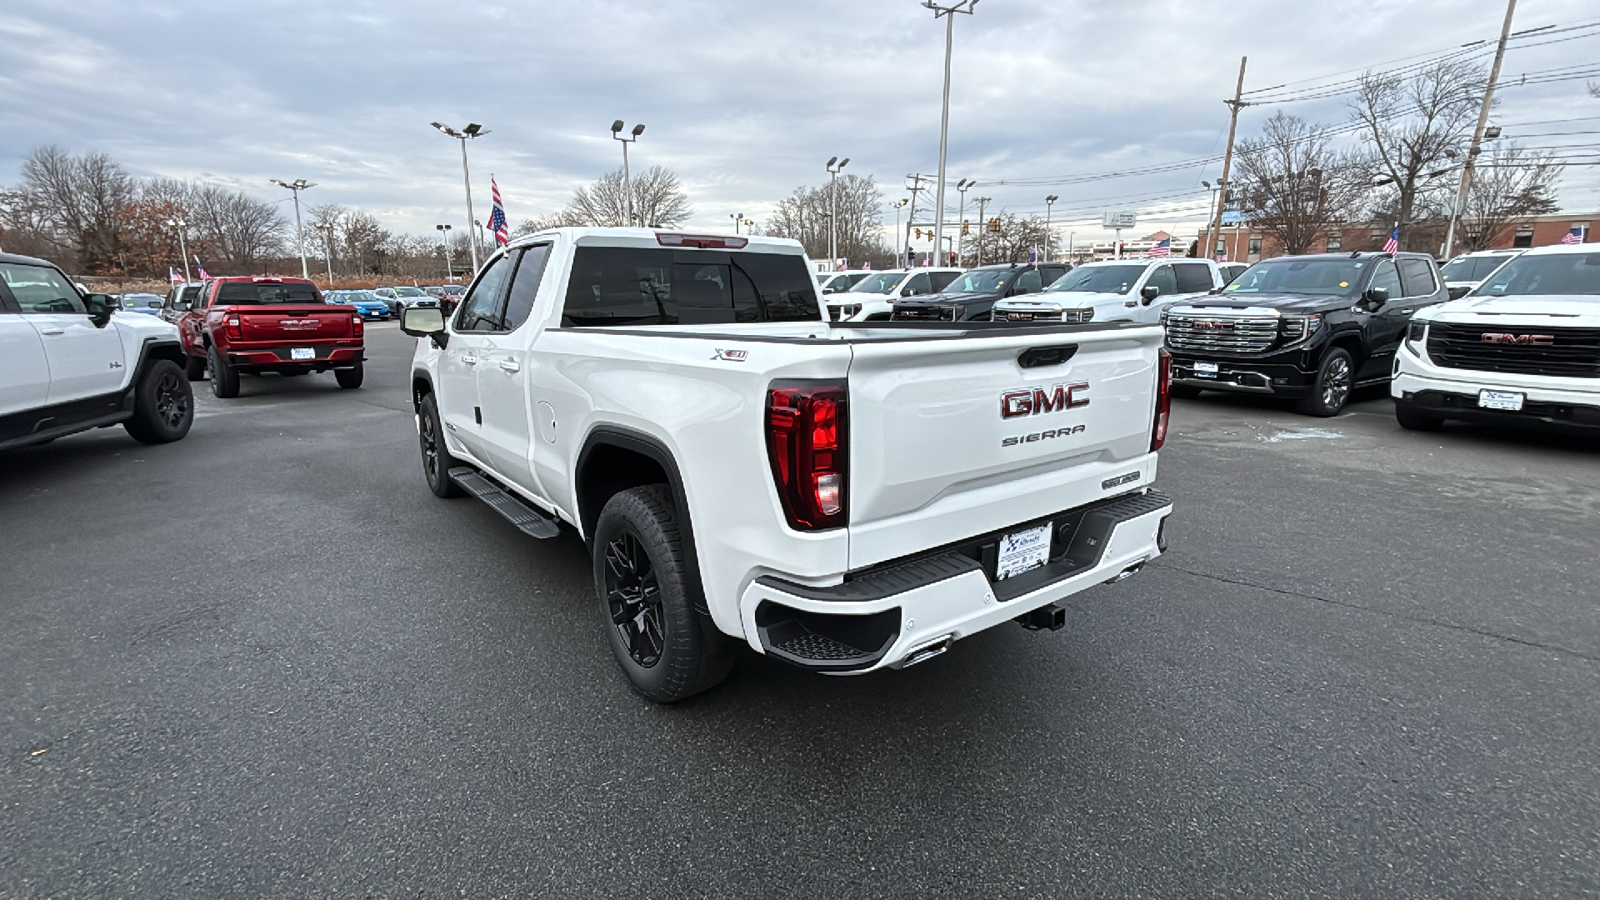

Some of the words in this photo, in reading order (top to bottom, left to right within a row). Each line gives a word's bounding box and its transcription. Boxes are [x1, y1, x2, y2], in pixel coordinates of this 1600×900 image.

[1192, 321, 1235, 330] GMC
[1481, 332, 1554, 346] GMC
[1001, 381, 1090, 420] GMC
[1001, 424, 1086, 447] SIERRA
